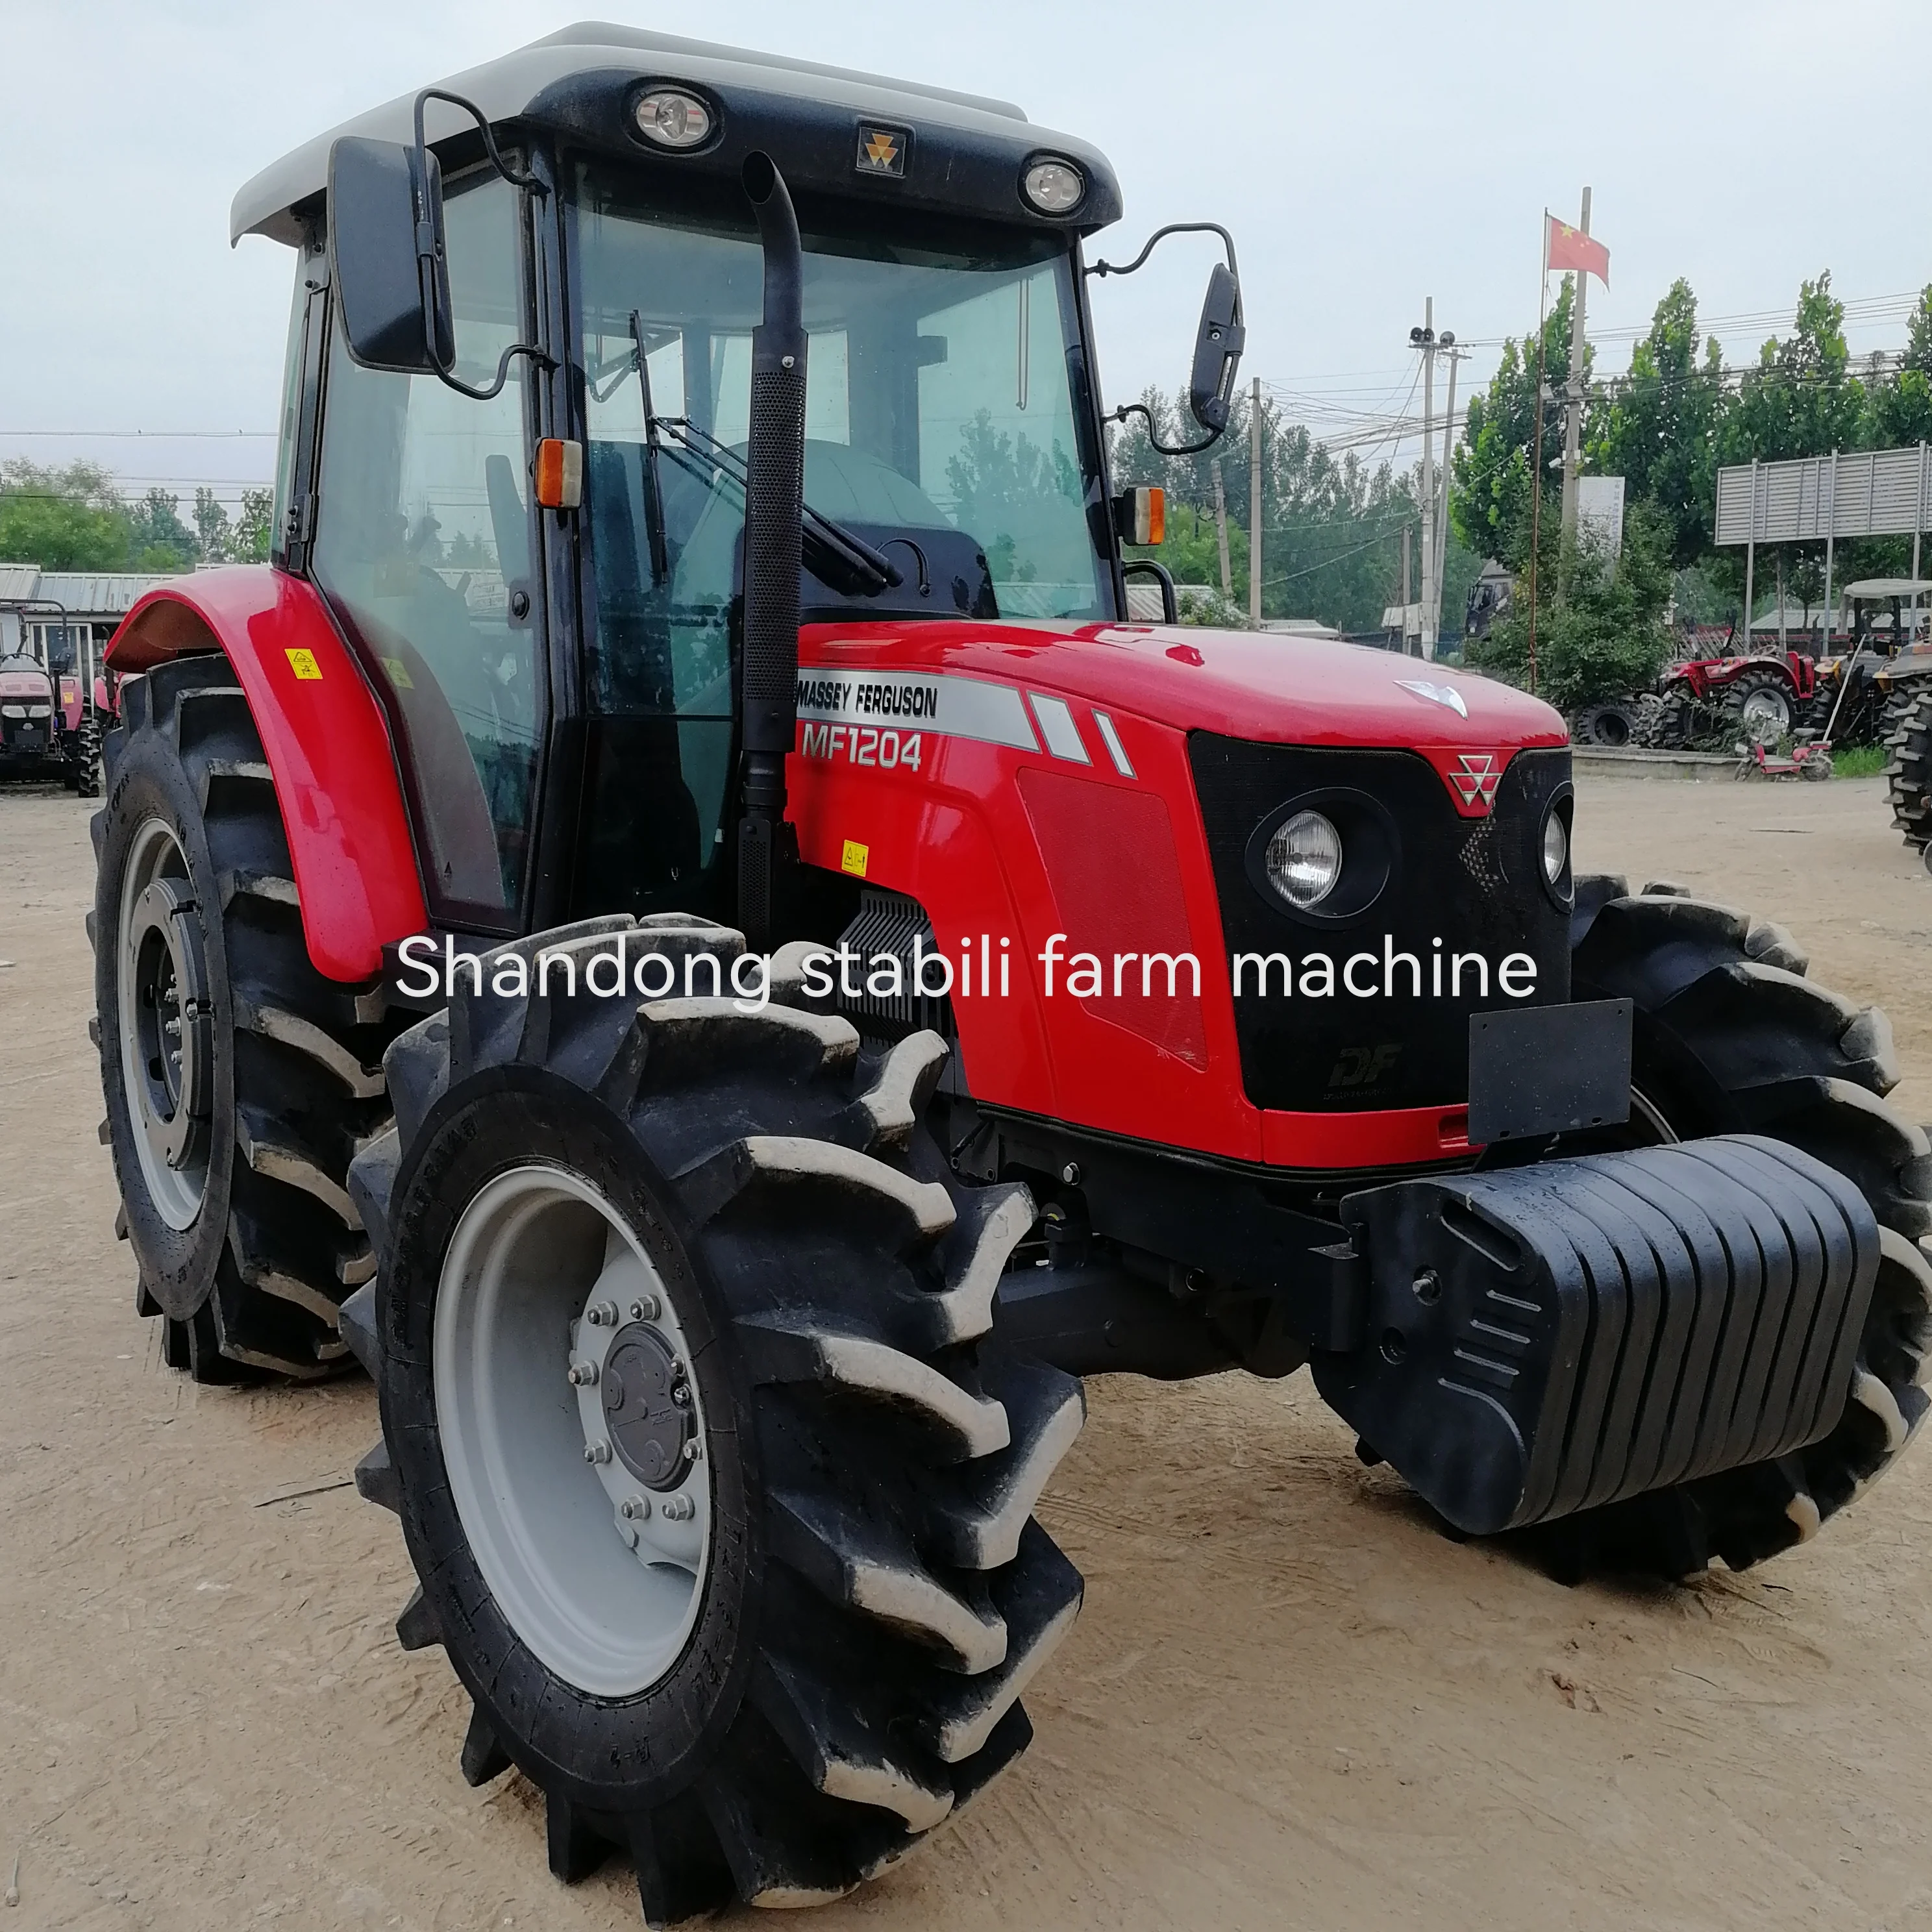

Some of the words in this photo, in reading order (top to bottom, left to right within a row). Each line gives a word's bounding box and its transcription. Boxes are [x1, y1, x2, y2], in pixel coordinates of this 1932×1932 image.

[797, 680, 851, 712] MASSEY
[856, 684, 938, 719] FERGUSON
[802, 723, 922, 773] MF1204
[1328, 1041, 1405, 1086] DF
